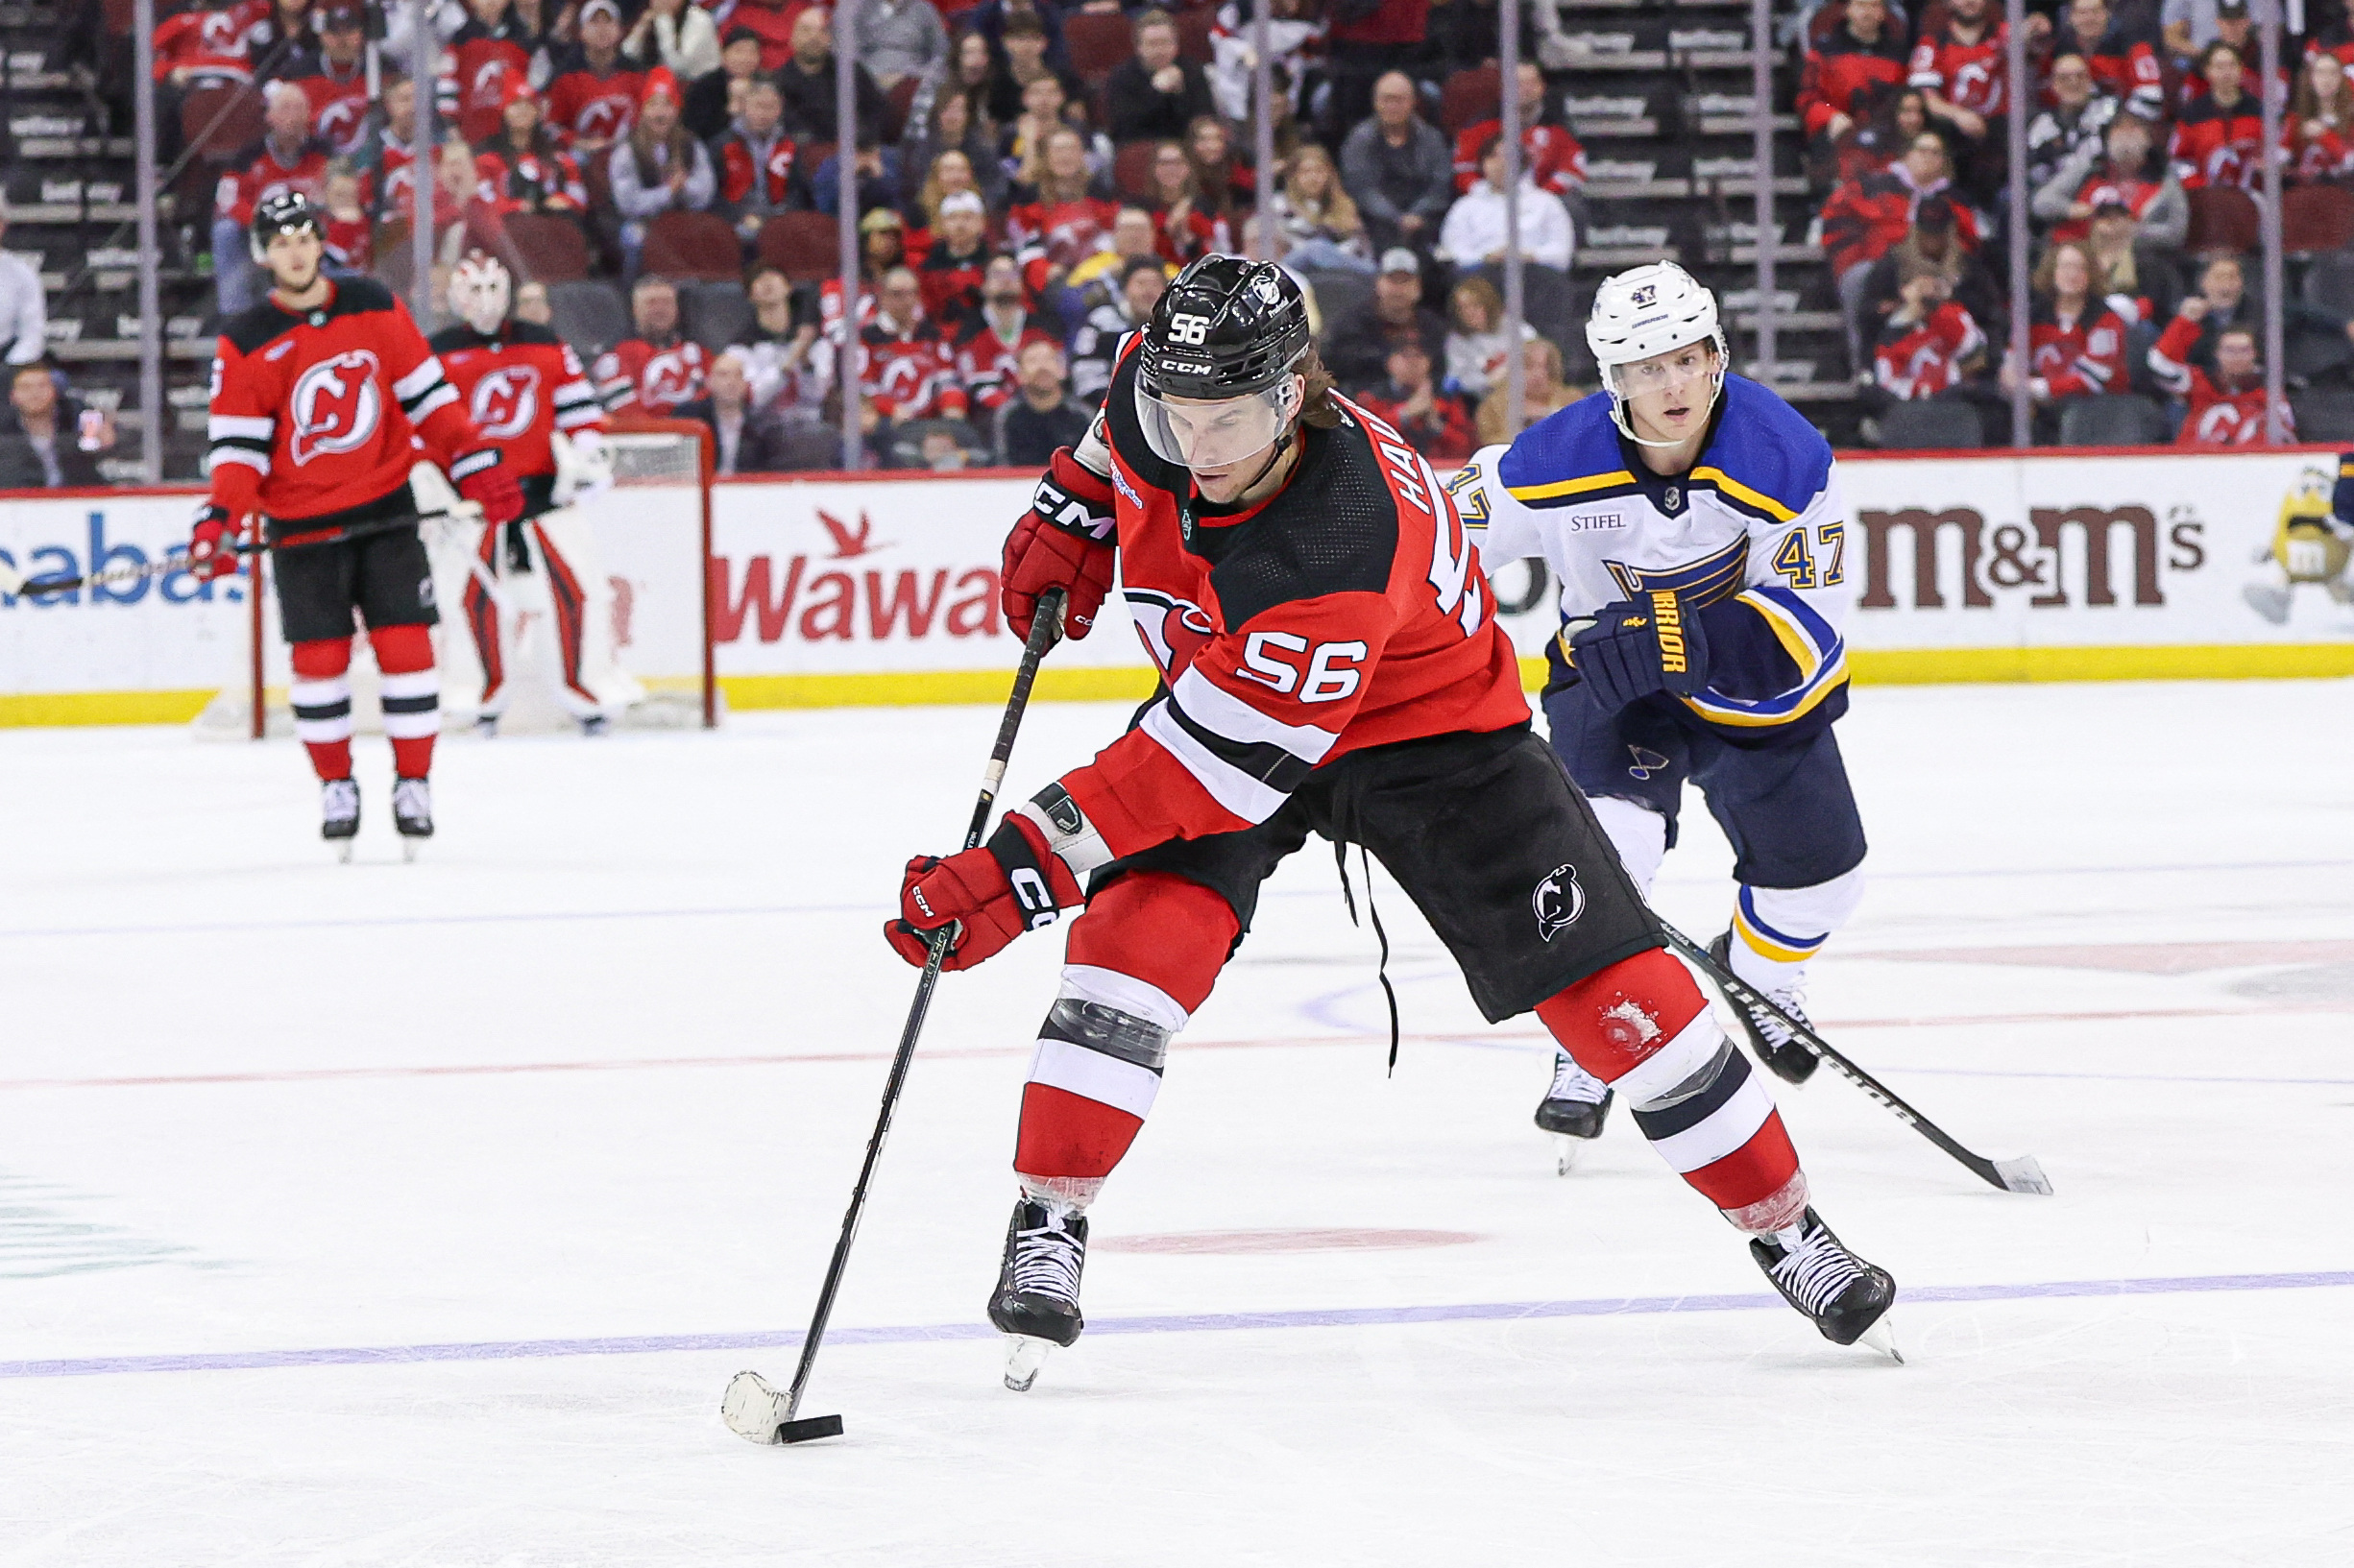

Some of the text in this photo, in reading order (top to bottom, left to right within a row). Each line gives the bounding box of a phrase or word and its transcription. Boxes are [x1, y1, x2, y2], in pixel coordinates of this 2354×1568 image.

[1167, 312, 1211, 346] 56
[1161, 359, 1213, 375] CCM
[1571, 514, 1627, 532] STIFEL
[1771, 520, 1845, 590] 47
[712, 554, 1001, 646] Wawa
[1235, 630, 1369, 705] 56
[912, 885, 934, 917] CCM
